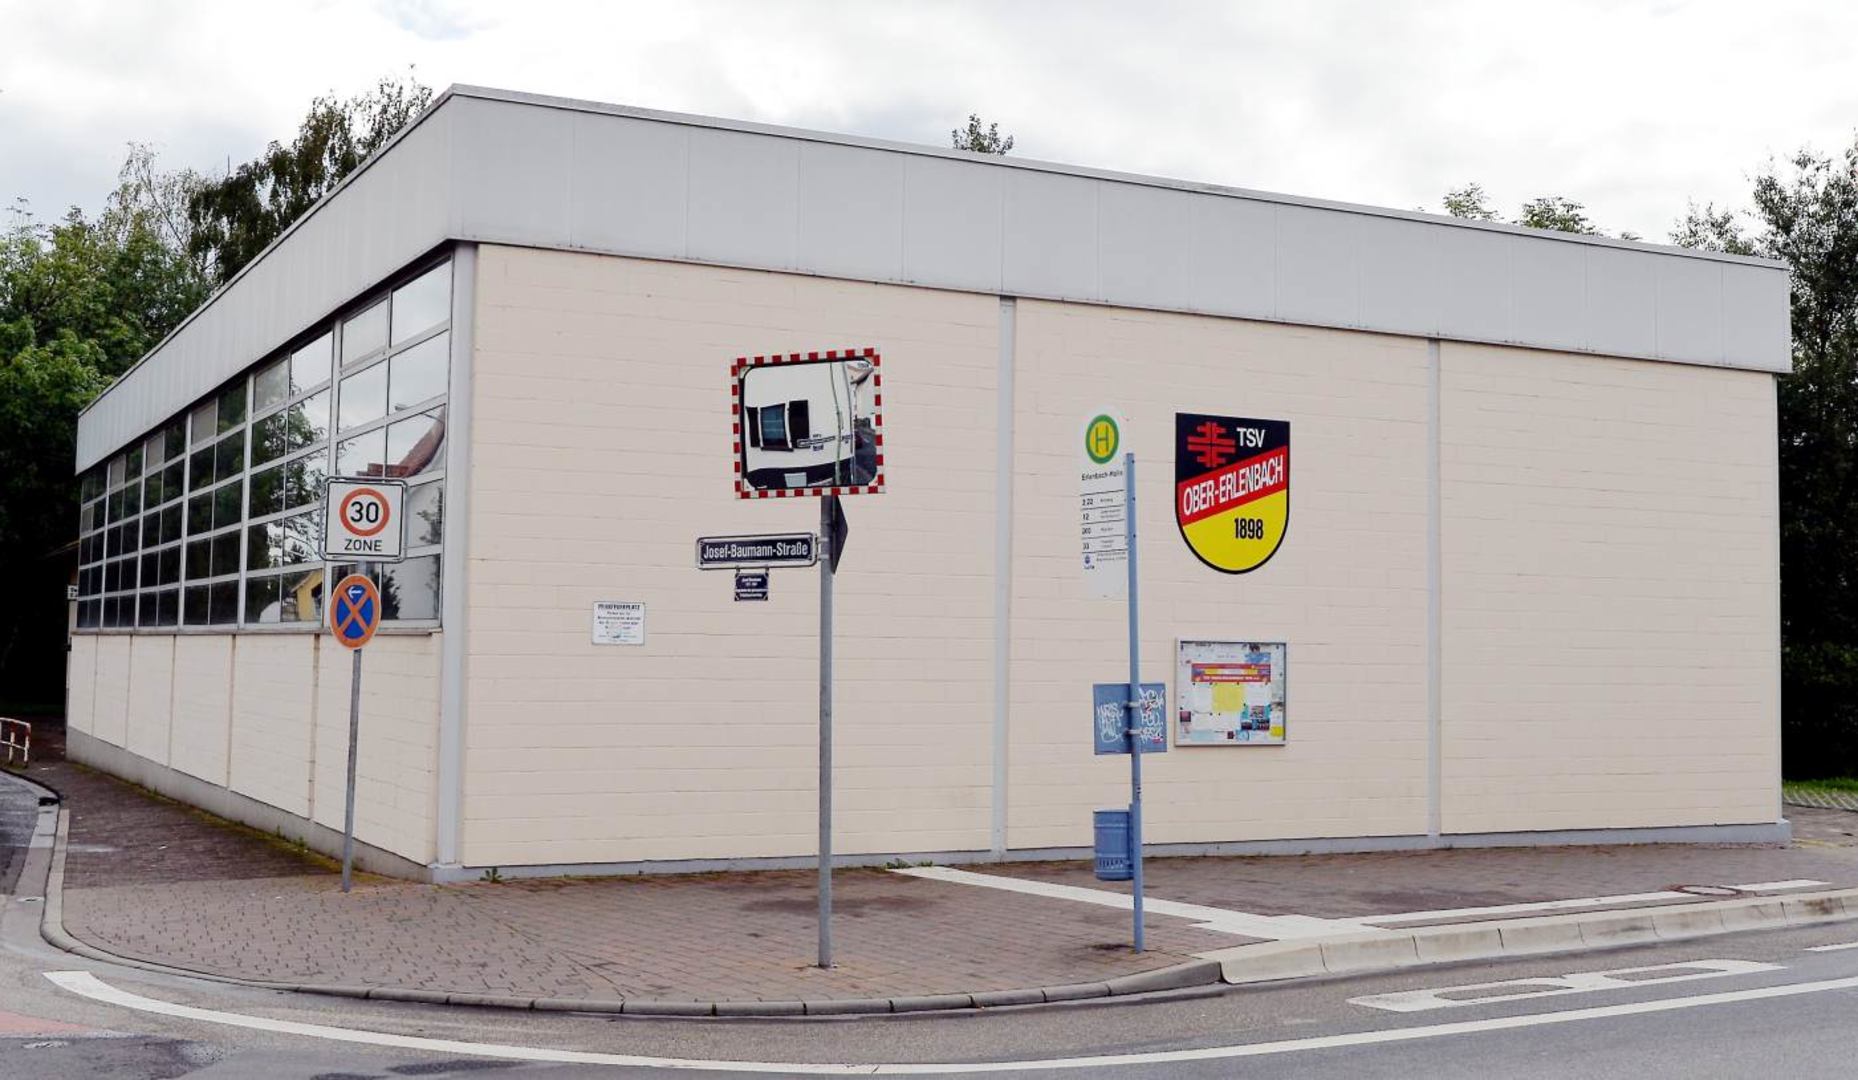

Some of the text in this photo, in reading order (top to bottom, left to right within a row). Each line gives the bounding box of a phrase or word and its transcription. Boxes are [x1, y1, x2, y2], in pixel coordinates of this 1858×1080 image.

[1095, 424, 1109, 453] H
[1236, 427, 1265, 448] TSV
[1183, 453, 1284, 515] OBER-ERLENBACH
[350, 501, 379, 523] 30
[1234, 518, 1264, 540] 1898
[344, 538, 383, 552] ZONE
[703, 541, 809, 559] Josef-Baumann-Straße
